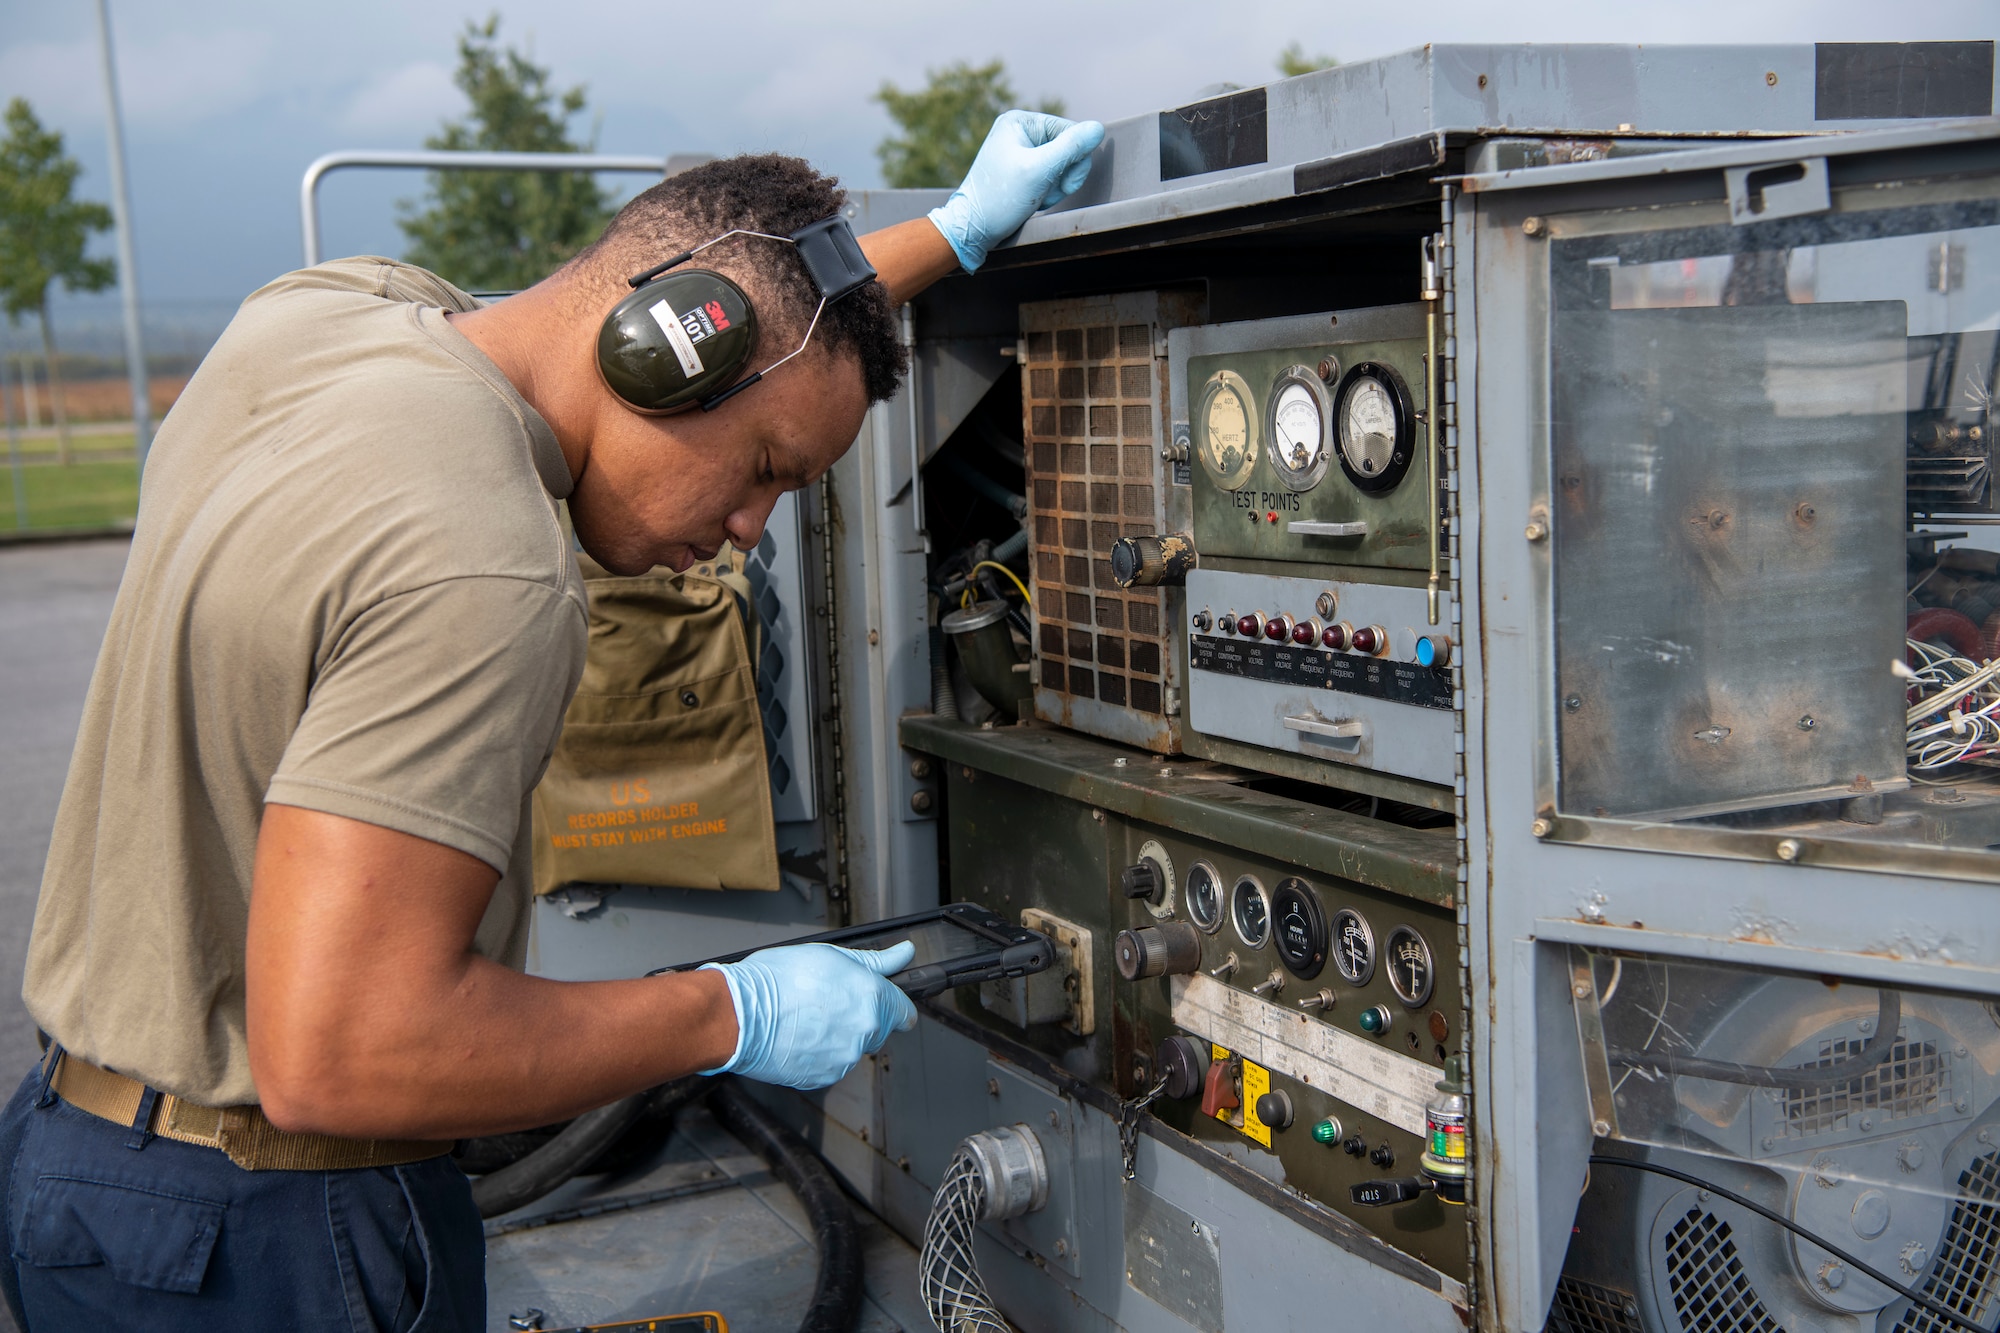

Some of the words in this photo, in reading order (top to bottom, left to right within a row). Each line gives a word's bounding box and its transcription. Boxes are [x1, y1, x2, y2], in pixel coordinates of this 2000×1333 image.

[705, 300, 731, 331] 3M
[696, 308, 714, 334] OPTIME
[681, 314, 706, 343] 101
[1222, 433, 1239, 442] HERTZ
[1231, 490, 1257, 508] TEST
[1261, 492, 1300, 512] POINTS
[1248, 656, 1264, 665] VOLTAGE
[1274, 661, 1292, 670] VOLTAGE
[1300, 664, 1325, 674] FREQUENCY
[1330, 668, 1355, 679] FREQUENCY
[1394, 669, 1415, 679] GROUND
[1367, 675, 1380, 683] LOAD
[1397, 679, 1411, 688] FAULT
[1433, 695, 1453, 706] PROTE
[567, 808, 637, 830] RECORDS
[641, 802, 700, 821] HOLDER
[551, 833, 587, 849] MUST
[591, 830, 626, 848] STAY
[629, 826, 667, 844] WITH
[671, 818, 728, 839] ENGINE
[1290, 925, 1303, 935] HOURS
[1214, 1048, 1229, 1057] CAUTIO
[1246, 1080, 1258, 1089] POWER
[1246, 1124, 1259, 1135] POWER
[1361, 1189, 1380, 1201] STOP
